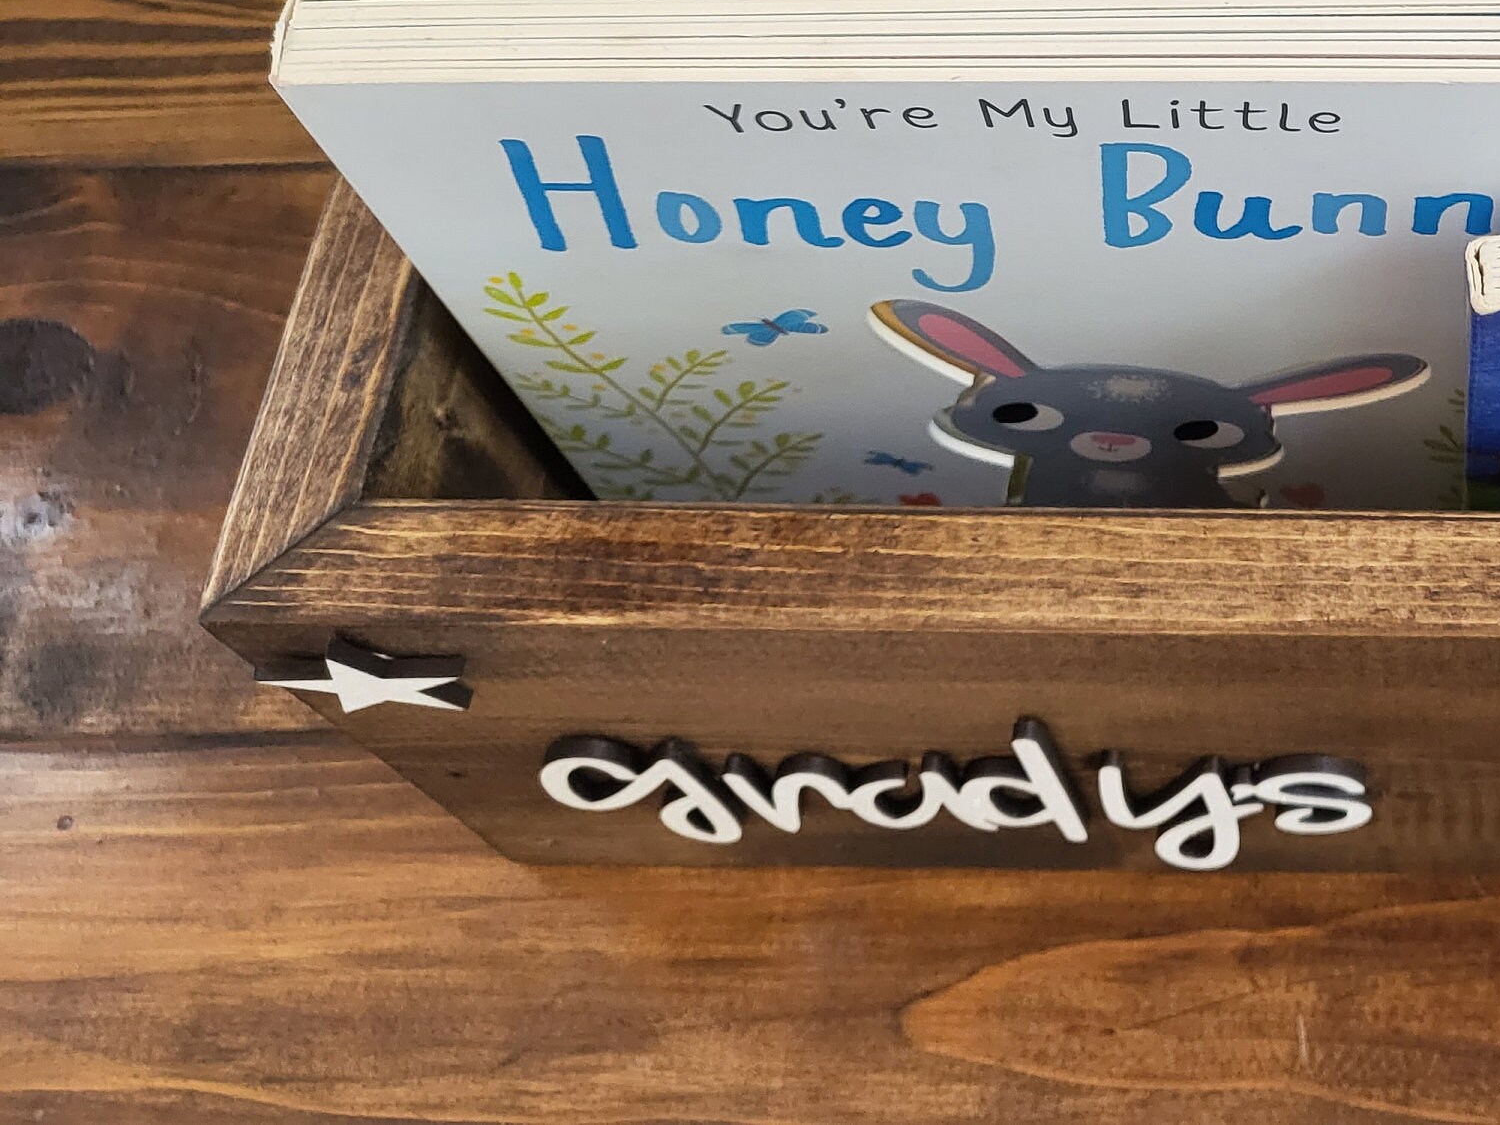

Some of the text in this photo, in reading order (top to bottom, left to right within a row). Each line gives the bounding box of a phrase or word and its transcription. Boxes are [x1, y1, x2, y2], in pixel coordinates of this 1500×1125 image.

[702, 98, 1344, 138] You're My Little
[498, 135, 996, 291] Honey
